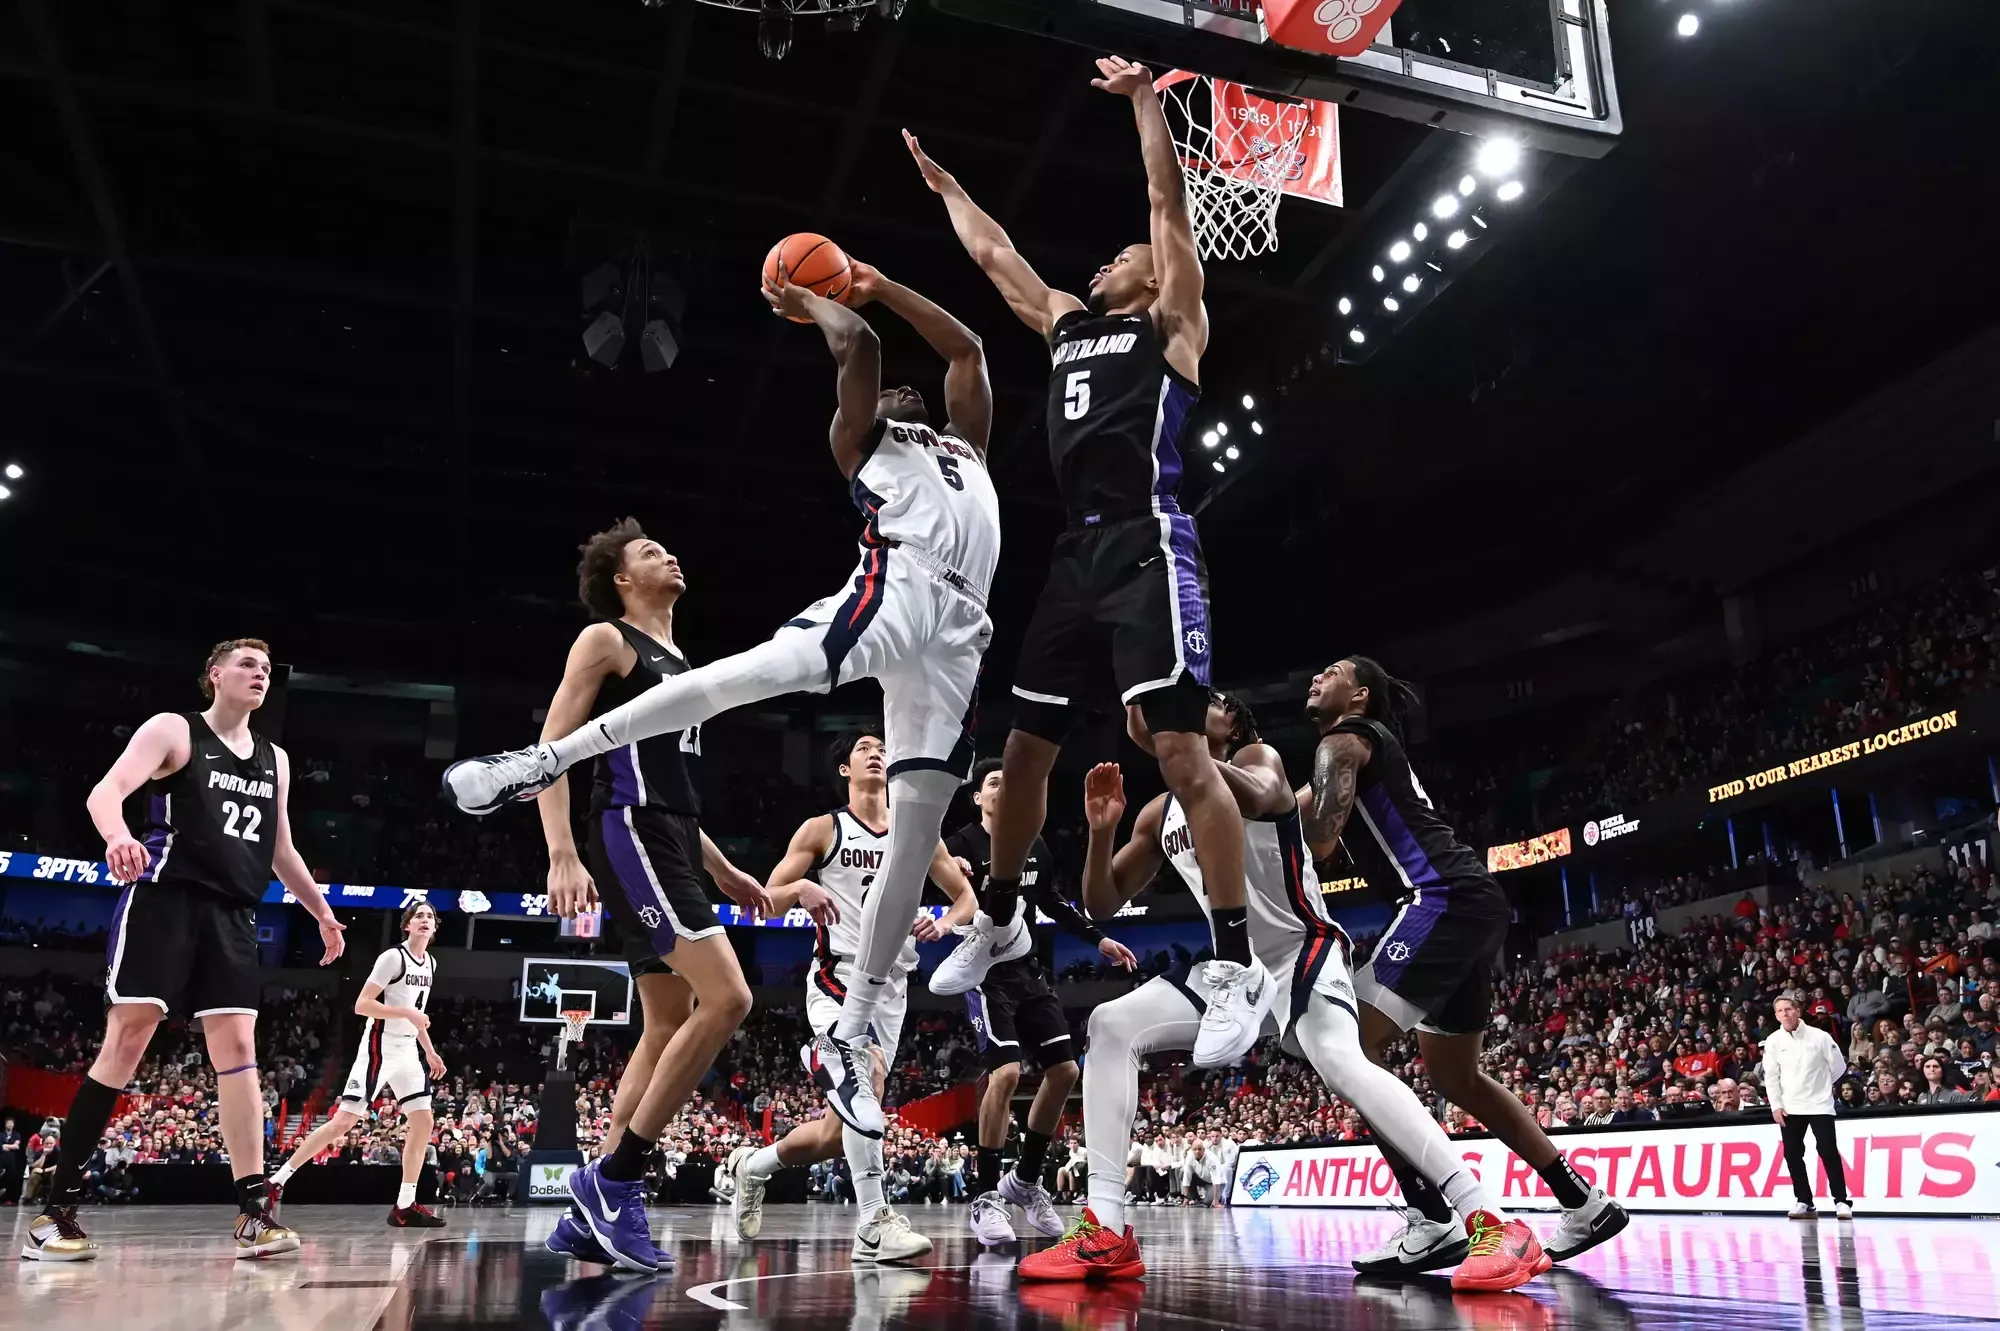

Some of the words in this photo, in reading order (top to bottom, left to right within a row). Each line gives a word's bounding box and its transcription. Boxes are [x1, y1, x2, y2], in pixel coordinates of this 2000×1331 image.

[1064, 370, 1091, 420] 5
[936, 455, 964, 491] 5
[943, 568, 965, 590] ZAGS
[1708, 780, 1745, 802] FIND
[1745, 766, 1788, 790] YOUR
[1788, 741, 1861, 778] NEAREST
[1863, 710, 1957, 755] LOCATION
[208, 770, 274, 799] PORTLAND
[222, 800, 262, 842] 22
[1599, 813, 1625, 830] PIZZA
[1600, 819, 1641, 841] FACTORY
[840, 848, 884, 870] GONZ
[1948, 839, 1986, 868] 117
[33, 856, 99, 883] 3PT%
[1319, 878, 1352, 894] REST
[414, 990, 425, 1010] 4
